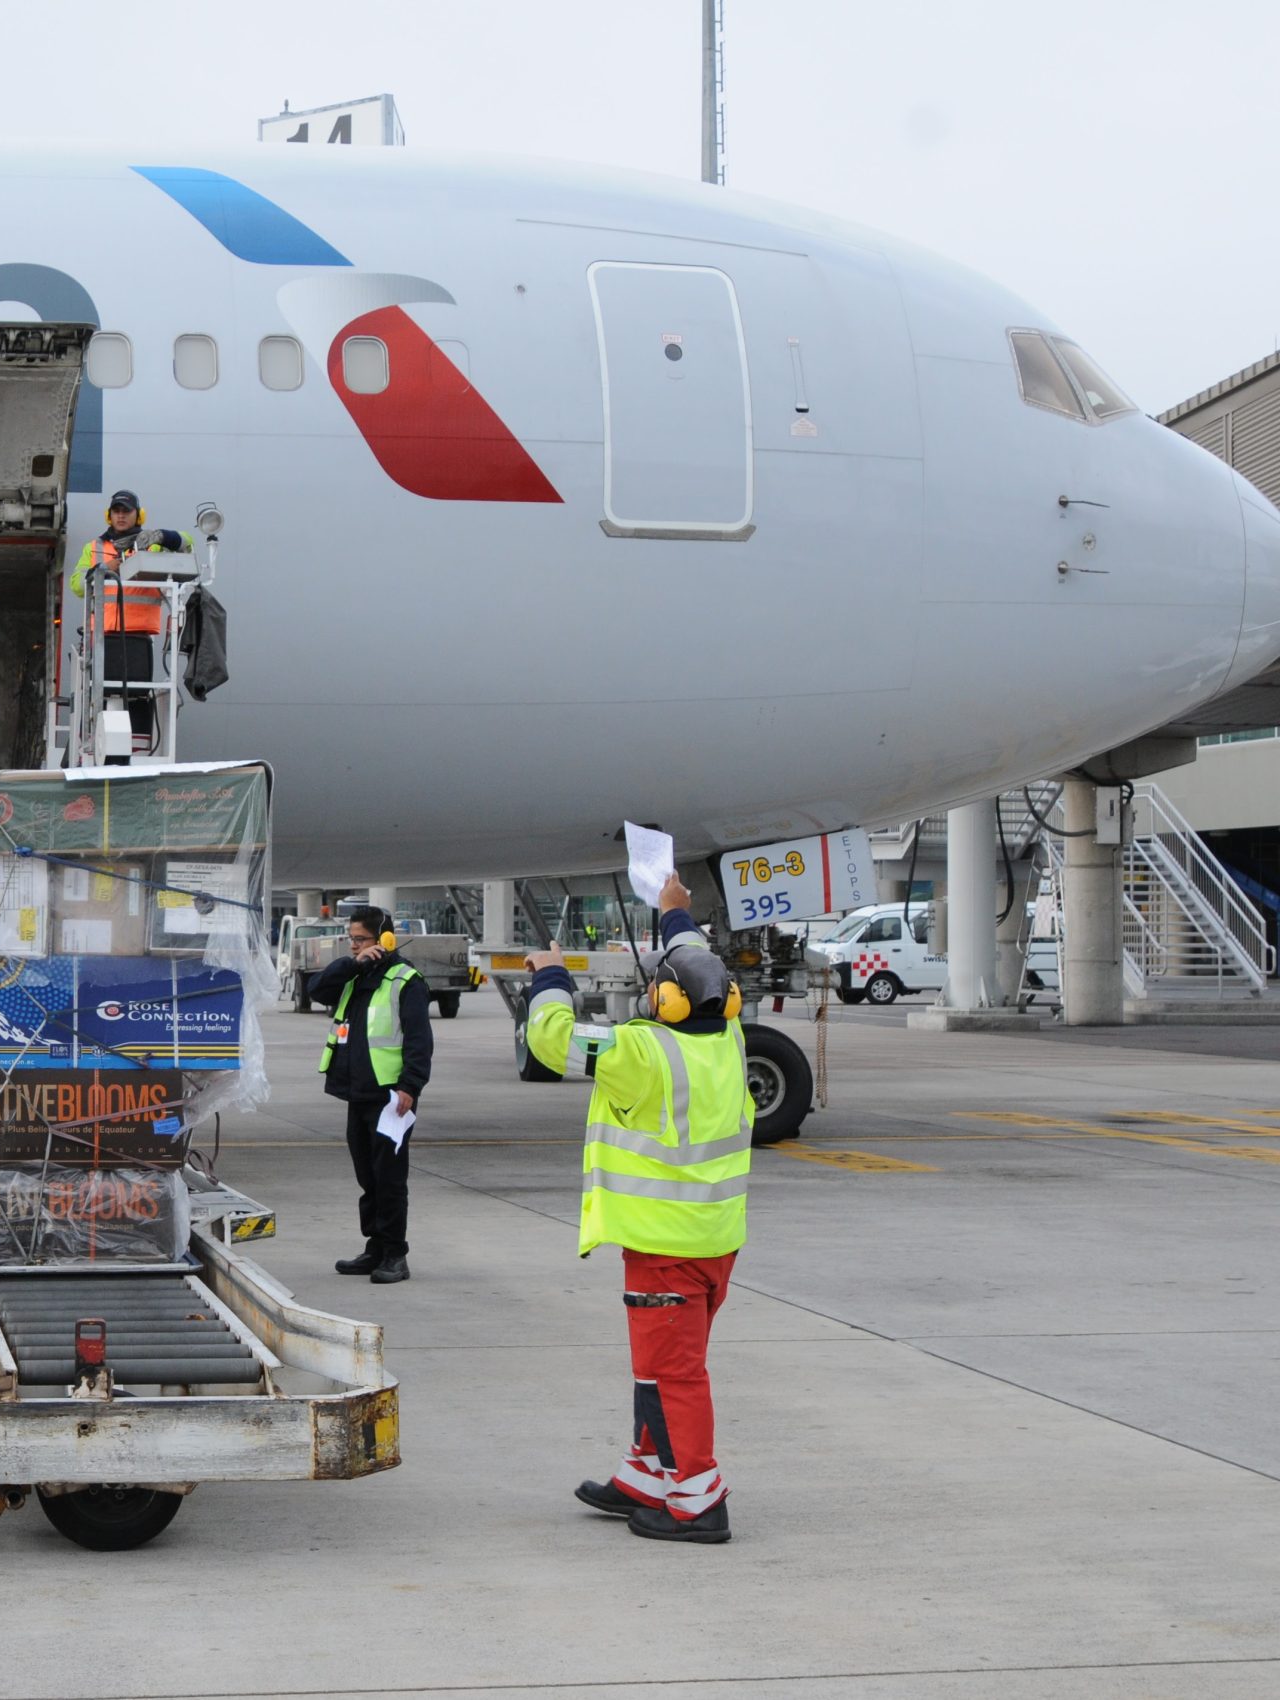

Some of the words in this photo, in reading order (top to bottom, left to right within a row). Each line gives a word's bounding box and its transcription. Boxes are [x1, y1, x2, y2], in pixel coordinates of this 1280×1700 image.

[733, 850, 806, 887] 76-3
[841, 834, 862, 902] ETOPS
[740, 891, 793, 922] 395
[128, 1000, 170, 1011] ROSE
[165, 1023, 203, 1033] Exressing
[204, 1022, 232, 1033] feelings
[7, 1125, 26, 1134] Plus
[27, 1125, 51, 1134] Belle
[82, 1125, 93, 1134] de
